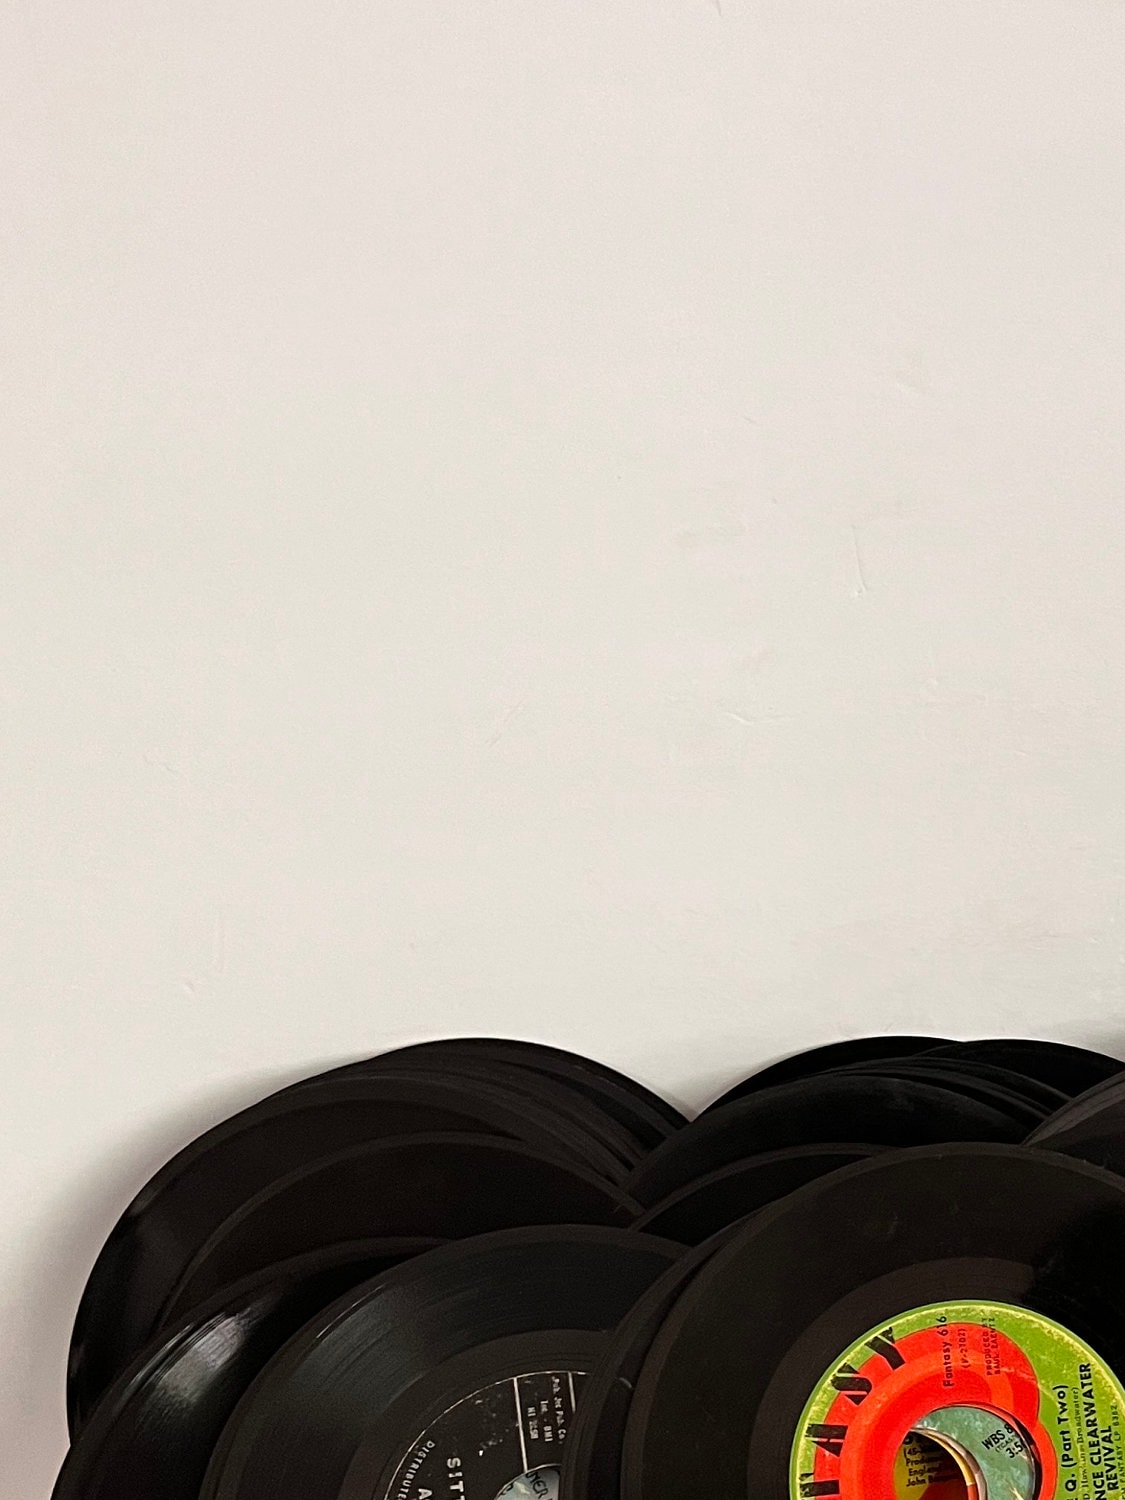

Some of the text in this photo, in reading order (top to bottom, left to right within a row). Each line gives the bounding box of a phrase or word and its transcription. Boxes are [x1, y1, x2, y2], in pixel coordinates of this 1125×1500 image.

[937, 1316, 954, 1386] Fantasy 616
[1054, 1385, 1070, 1424] Two)
[1079, 1363, 1101, 1466] CLEARWATER
[981, 1428, 1006, 1450] WBS
[1059, 1430, 1077, 1469] (Part
[1100, 1425, 1118, 1491] REVIVAL
[1062, 1473, 1077, 1492] Q.
